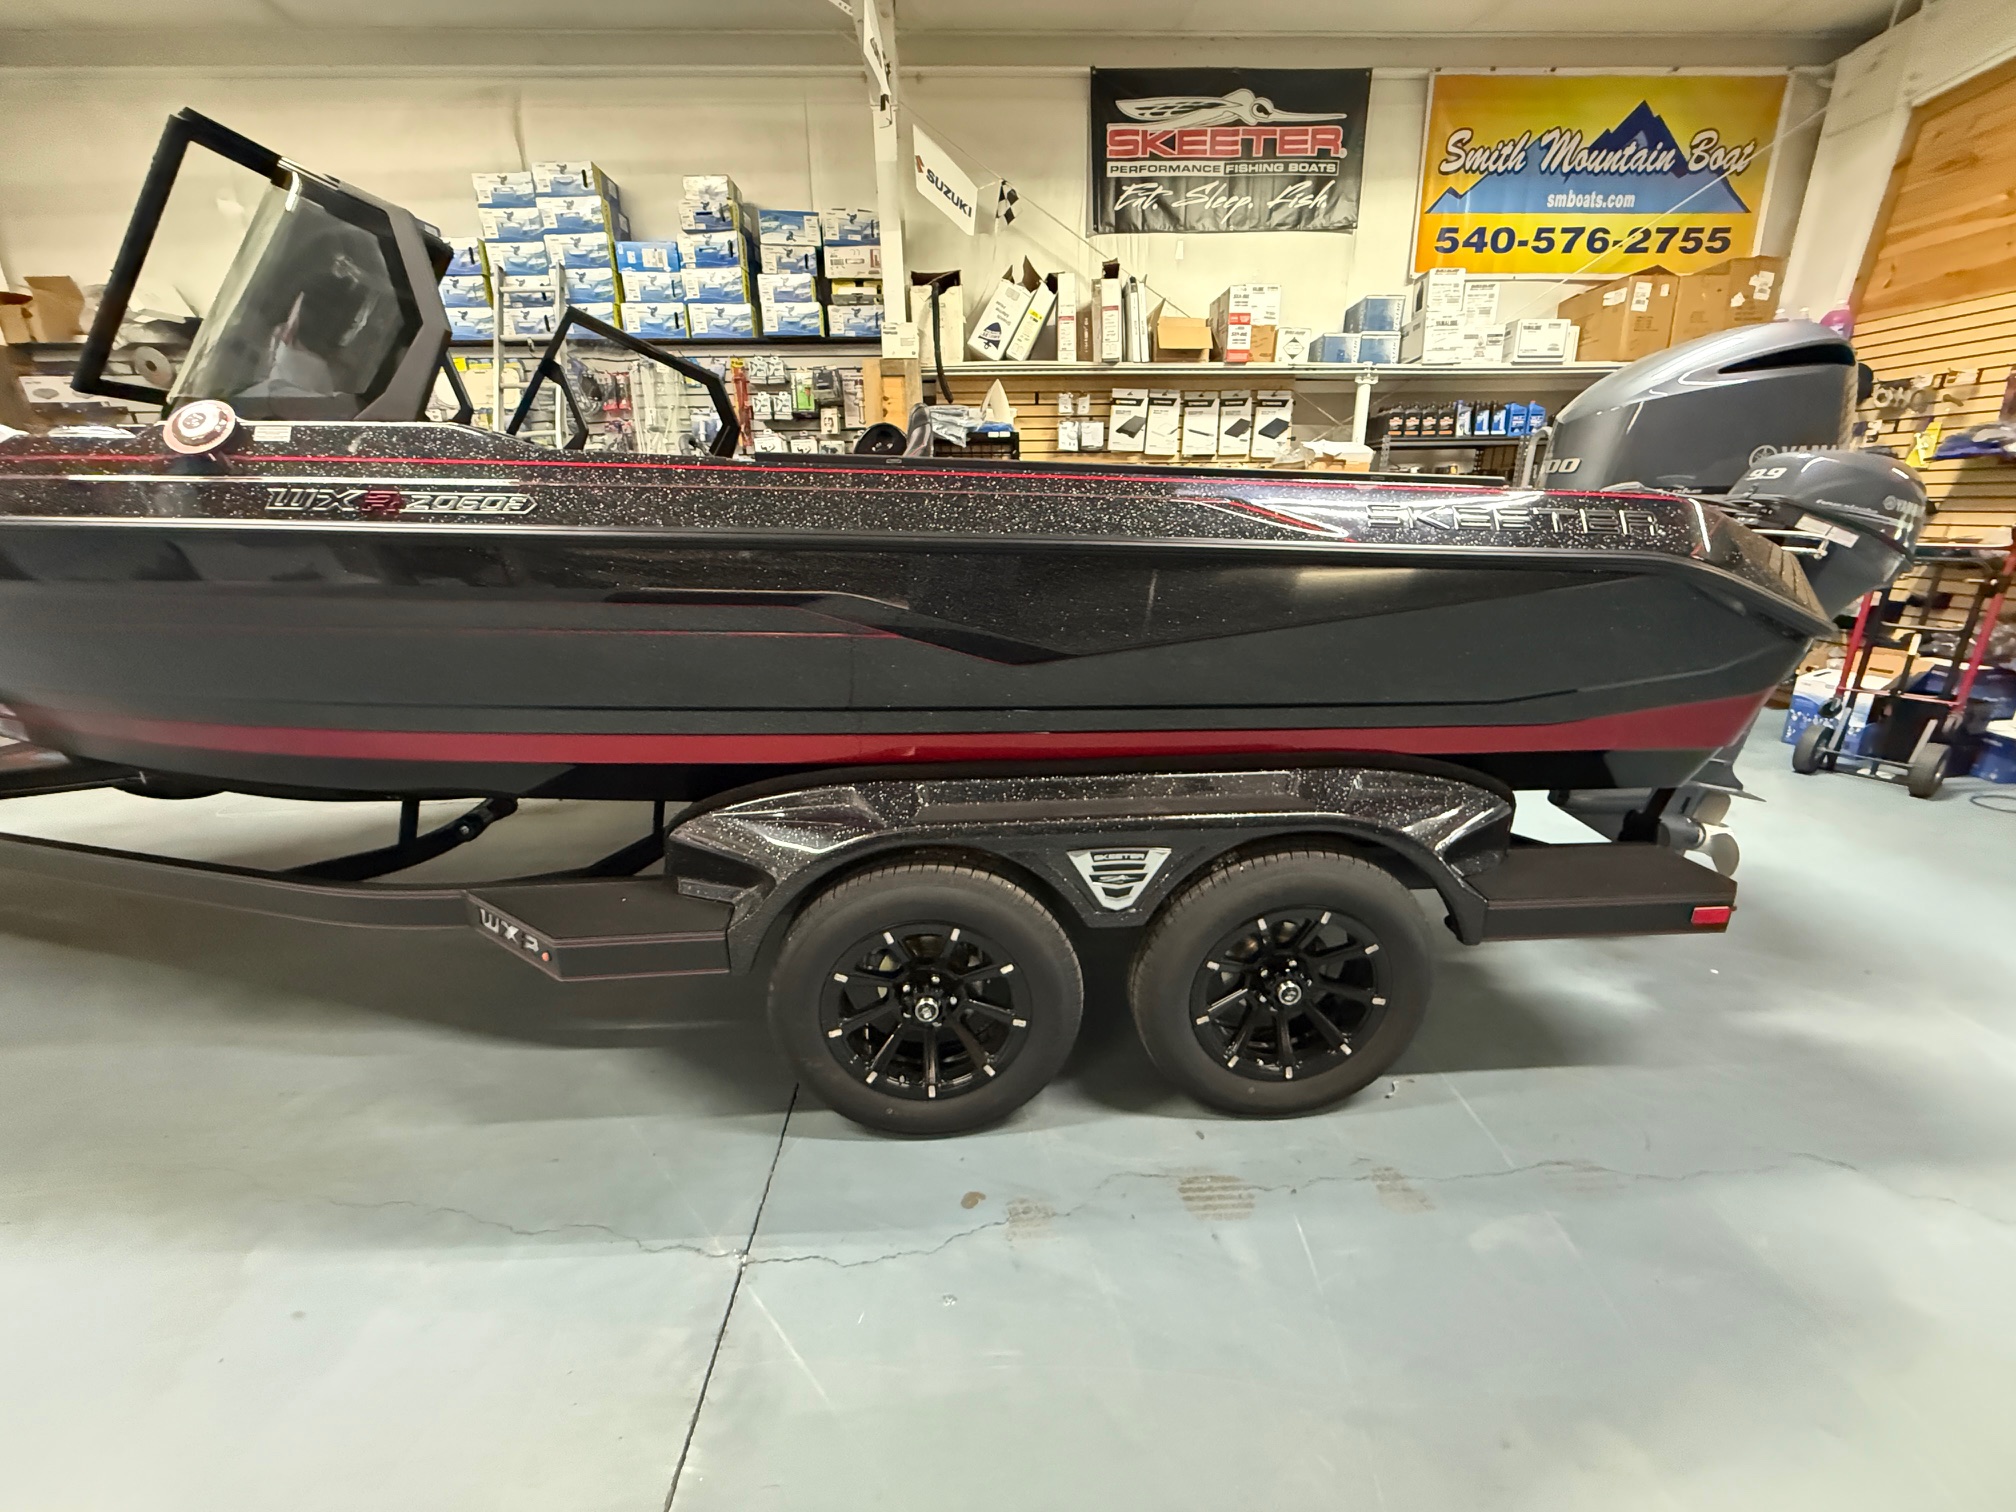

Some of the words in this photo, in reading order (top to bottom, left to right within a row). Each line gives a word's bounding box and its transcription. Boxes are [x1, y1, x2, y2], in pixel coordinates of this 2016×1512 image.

[1106, 126, 1342, 158] SKEETER
[1439, 129, 1532, 176] Smith
[1540, 127, 1677, 176] Mountain
[1687, 128, 1757, 175] Boat
[1110, 164, 1221, 175] PERFORMANCE
[1225, 163, 1284, 174] FISHING
[1288, 162, 1336, 174] BOATS
[926, 168, 972, 218] SUZUKI
[1172, 180, 1254, 225] Sleep.
[1546, 190, 1636, 208] smboats.com
[1434, 226, 1732, 255] 540-576-2755
[1365, 503, 1659, 537] SKEETER
